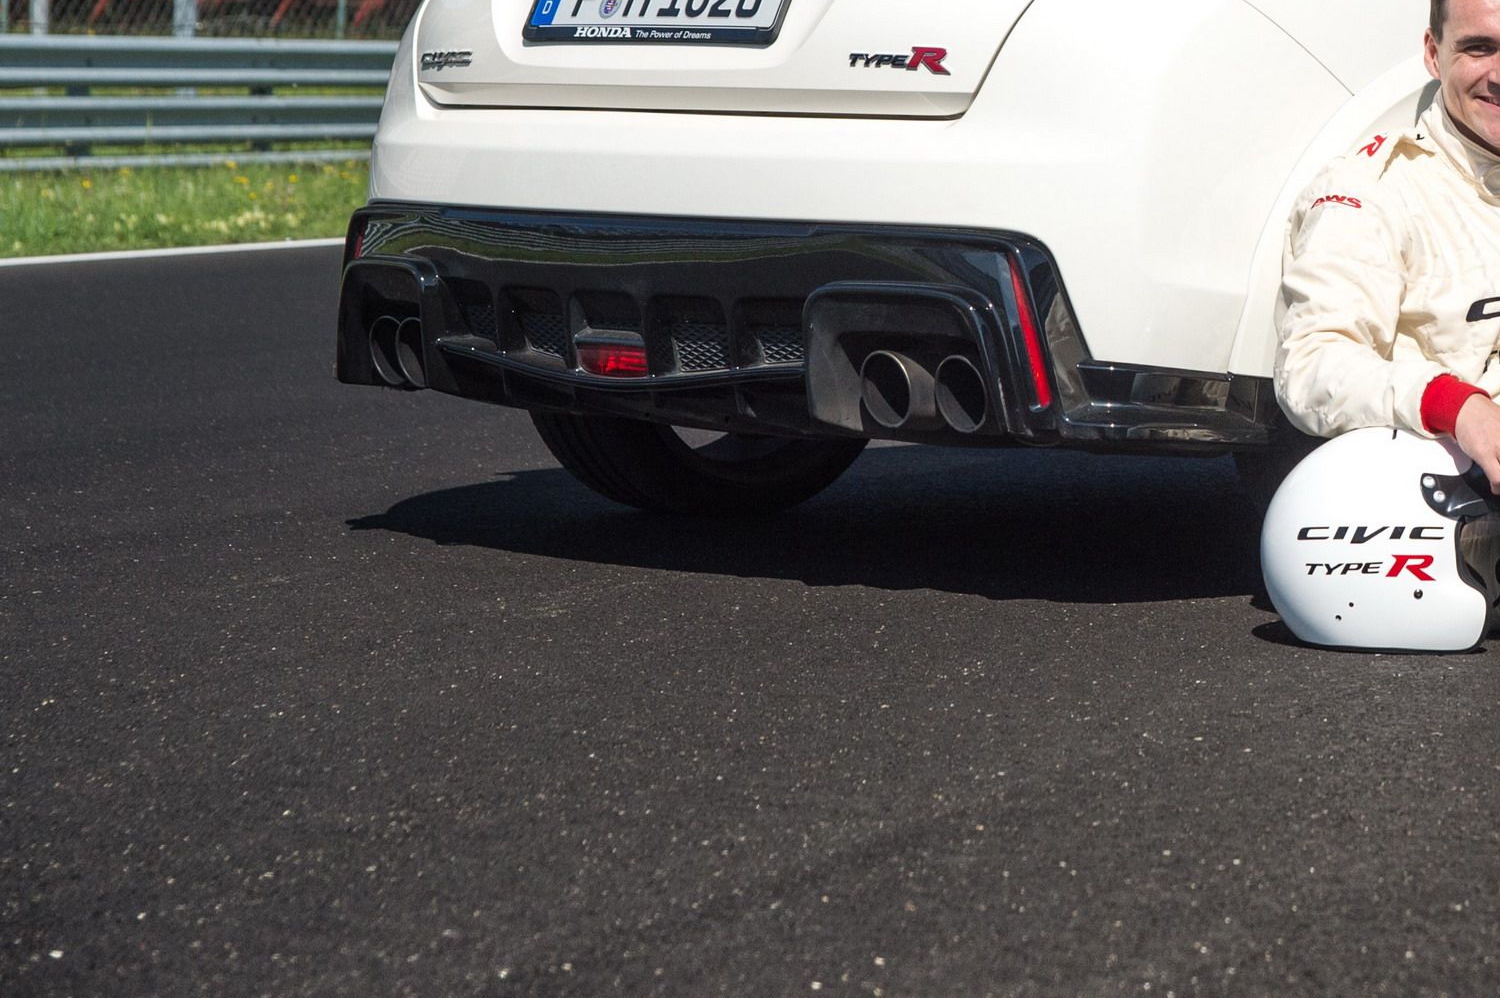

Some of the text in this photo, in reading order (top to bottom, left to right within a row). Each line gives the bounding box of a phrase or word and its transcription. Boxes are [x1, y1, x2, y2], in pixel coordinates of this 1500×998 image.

[541, 0, 552, 15] D
[573, 26, 632, 38] HONDA
[635, 29, 712, 40] The Power of Dreams
[849, 46, 951, 76] TYPE R
[1297, 525, 1445, 544] CIVIC
[1305, 554, 1436, 581] TYPE R
